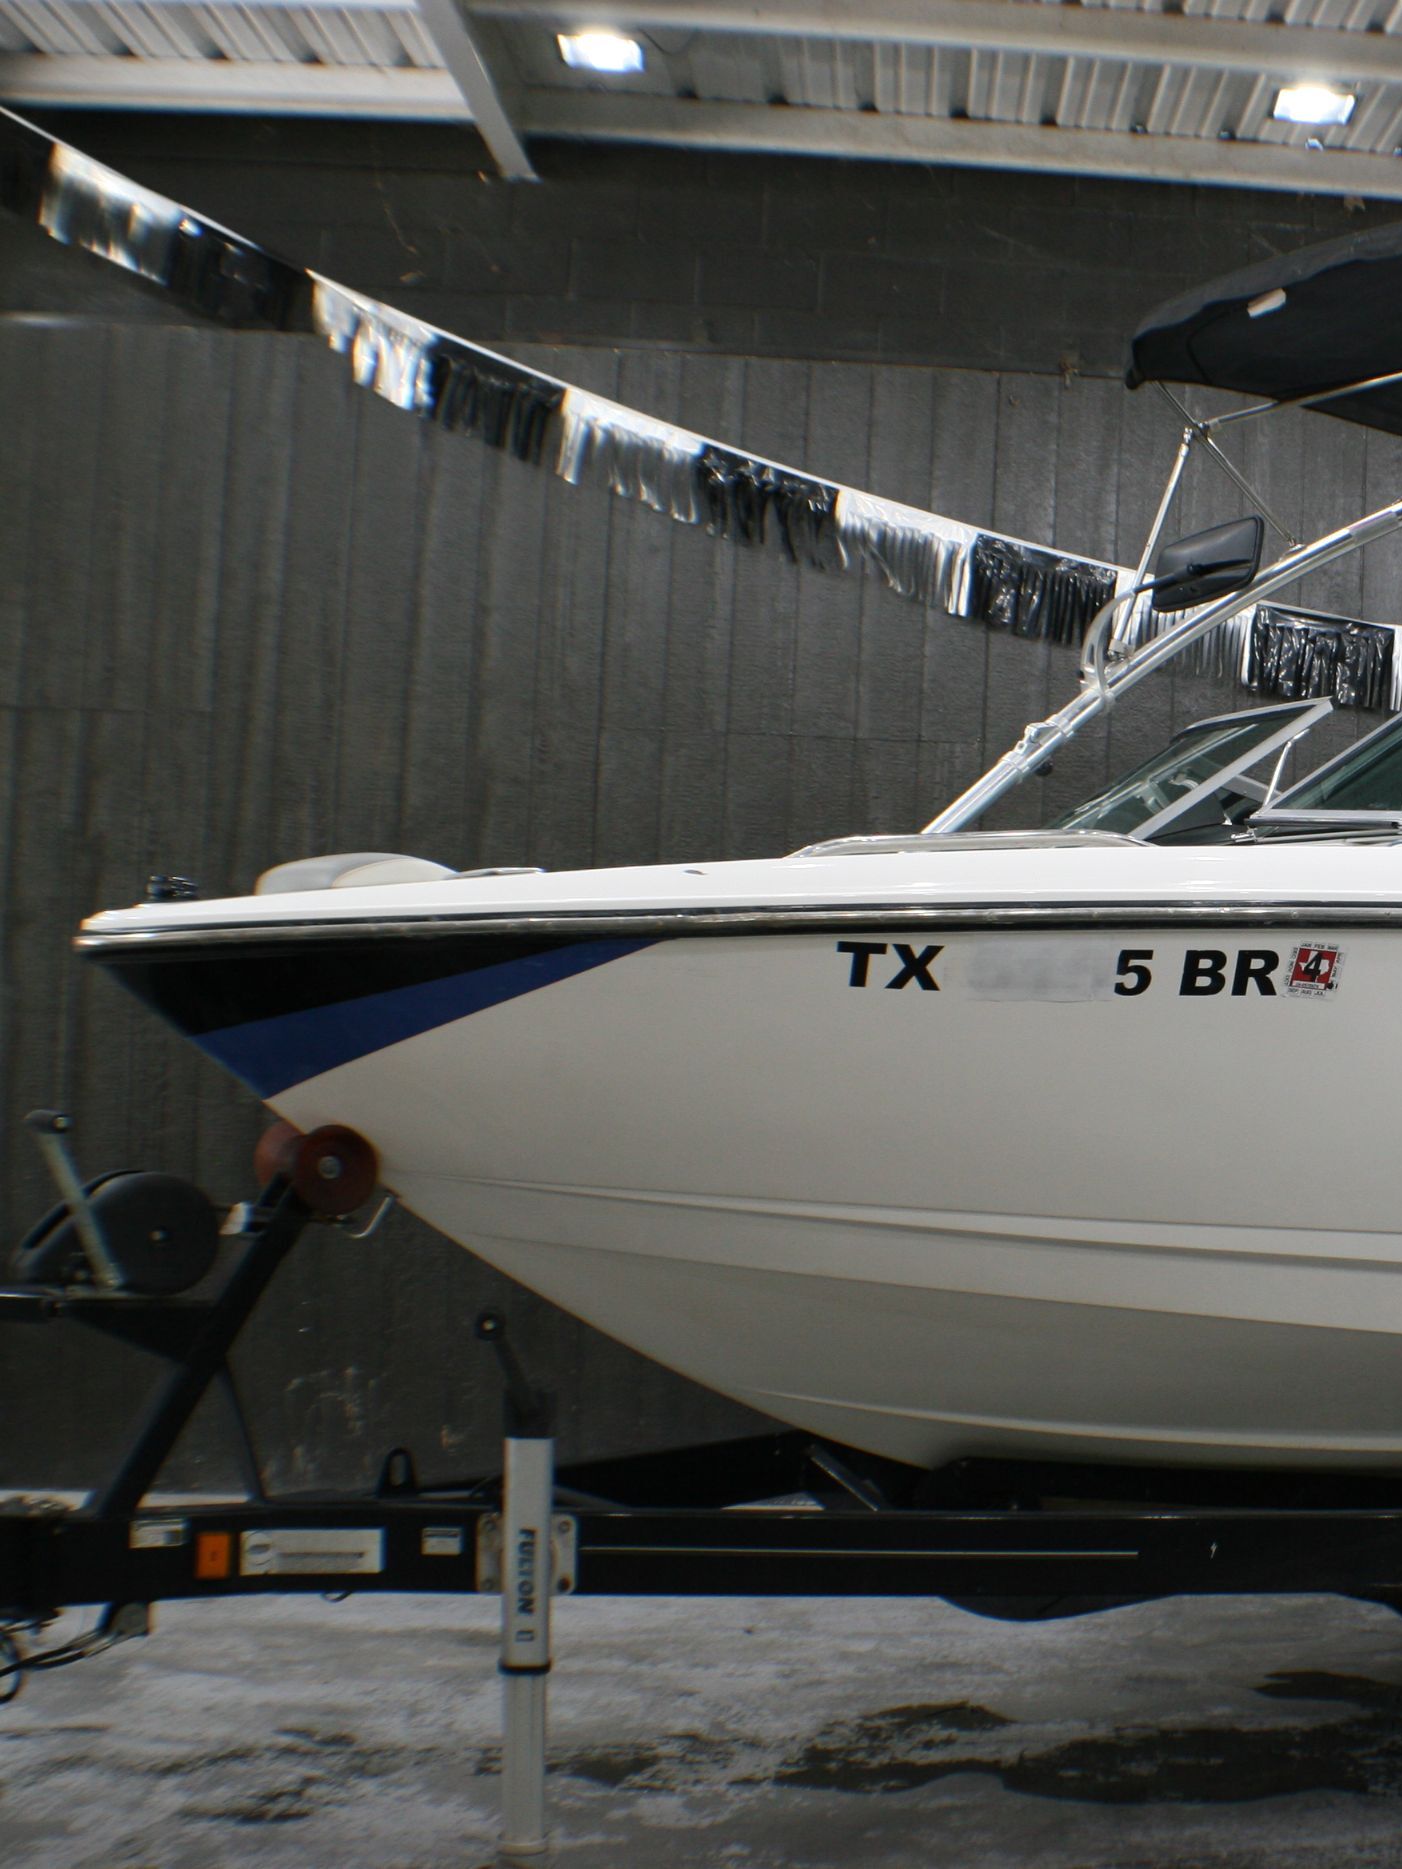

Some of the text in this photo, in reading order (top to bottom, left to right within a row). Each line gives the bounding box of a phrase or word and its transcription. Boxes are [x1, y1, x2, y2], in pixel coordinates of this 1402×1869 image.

[836, 941, 944, 991] TX
[1114, 950, 1152, 996] 5
[1179, 950, 1279, 996] BR
[1303, 951, 1322, 983] 4
[518, 1529, 536, 1615] FULTON
